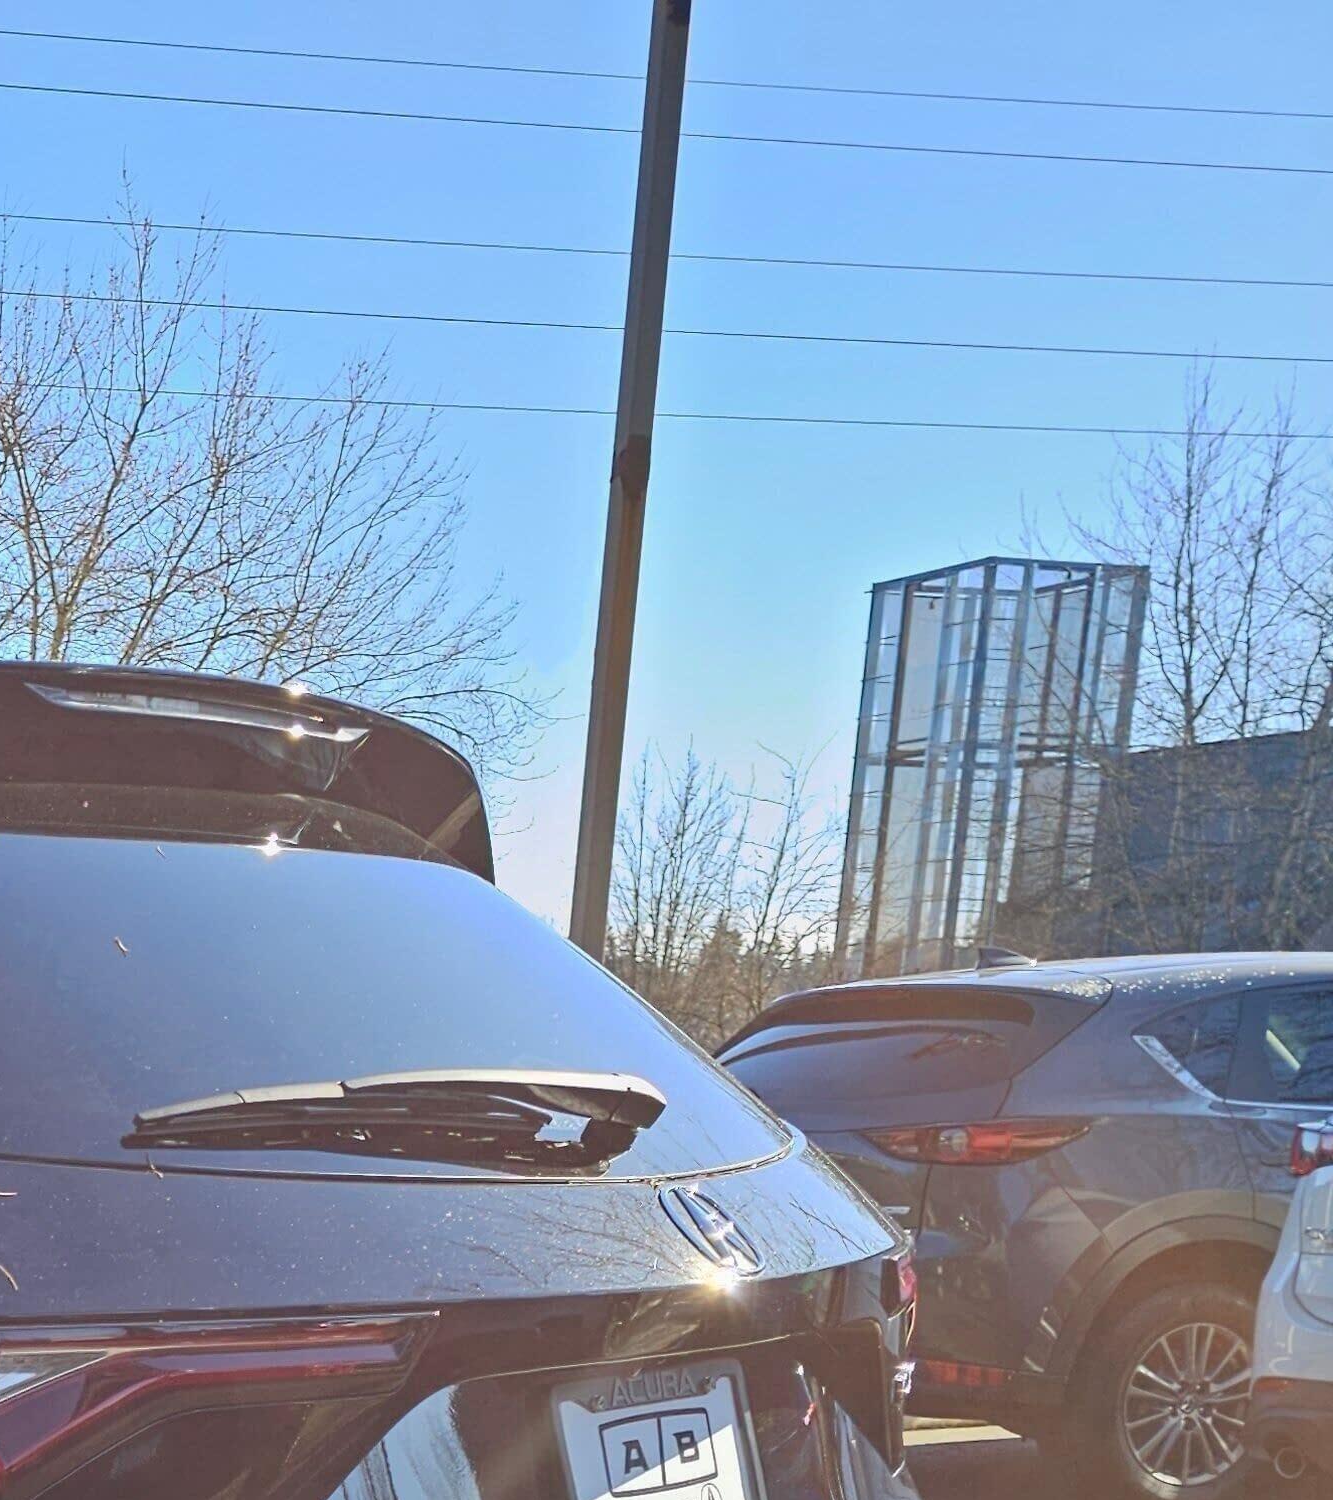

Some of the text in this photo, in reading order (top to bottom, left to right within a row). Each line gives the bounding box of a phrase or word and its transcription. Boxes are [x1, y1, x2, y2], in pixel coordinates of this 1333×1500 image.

[610, 1366, 697, 1408] ACURA
[622, 1429, 701, 1475] A B
